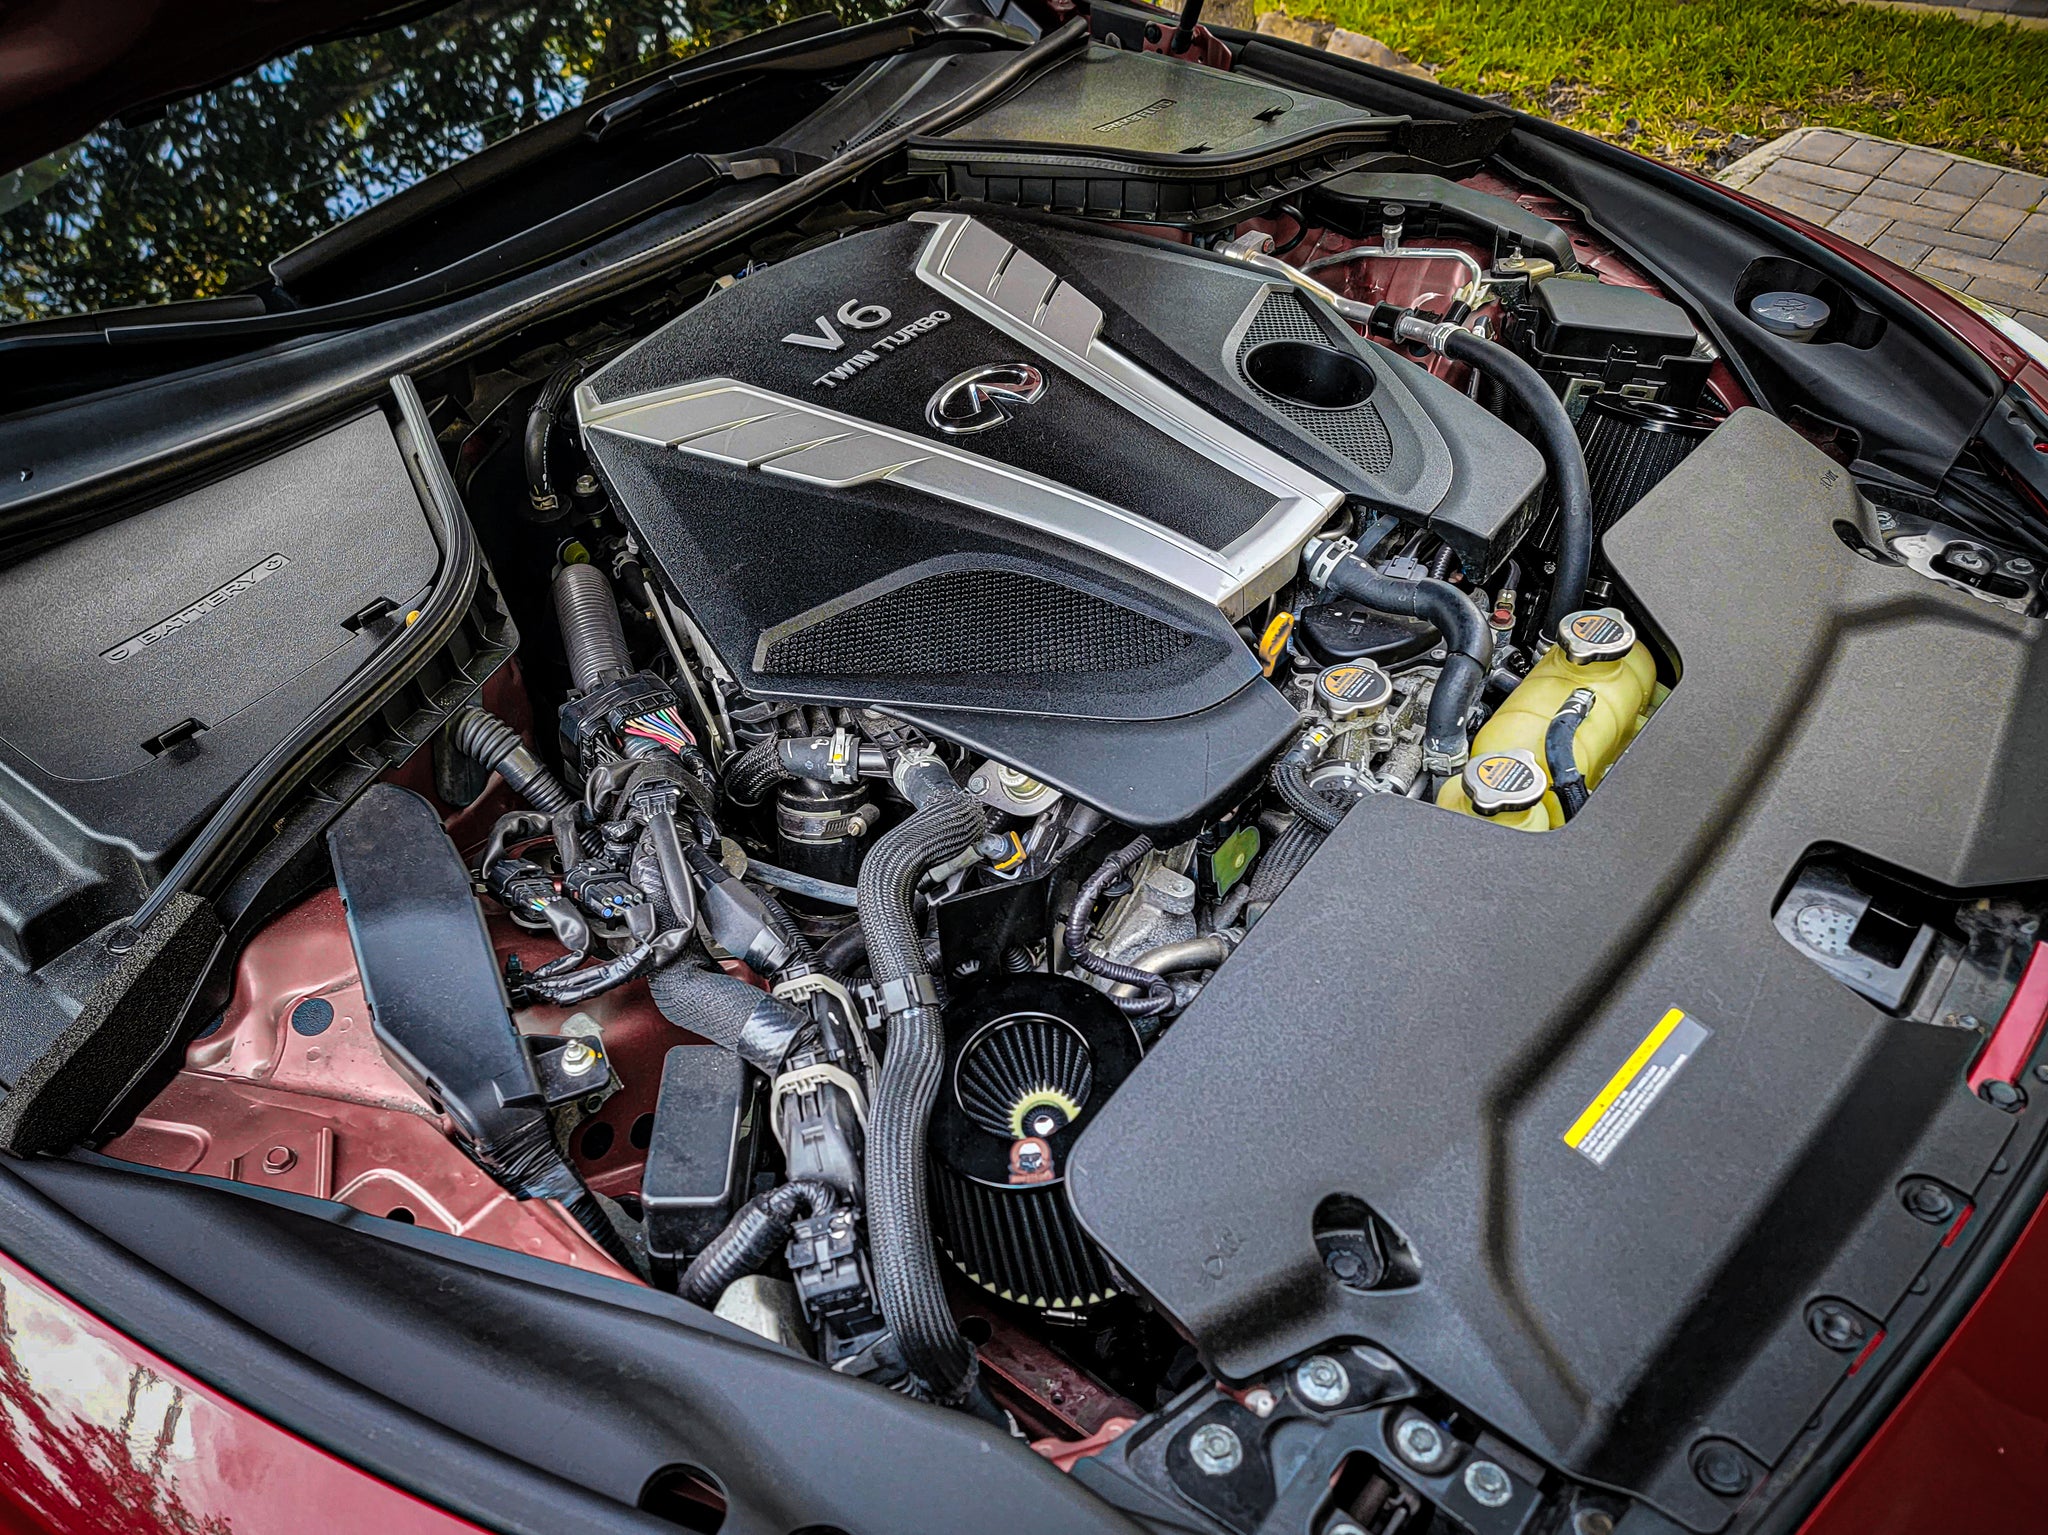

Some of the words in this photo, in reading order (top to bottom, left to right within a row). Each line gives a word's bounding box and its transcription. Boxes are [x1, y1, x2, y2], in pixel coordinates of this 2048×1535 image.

[1096, 115, 1141, 133] BRAKE
[1137, 100, 1174, 118] FLUID
[781, 298, 892, 351] V6
[812, 349, 880, 389] TWIN
[872, 310, 951, 352] TURBO
[136, 571, 256, 646] BATTERY
